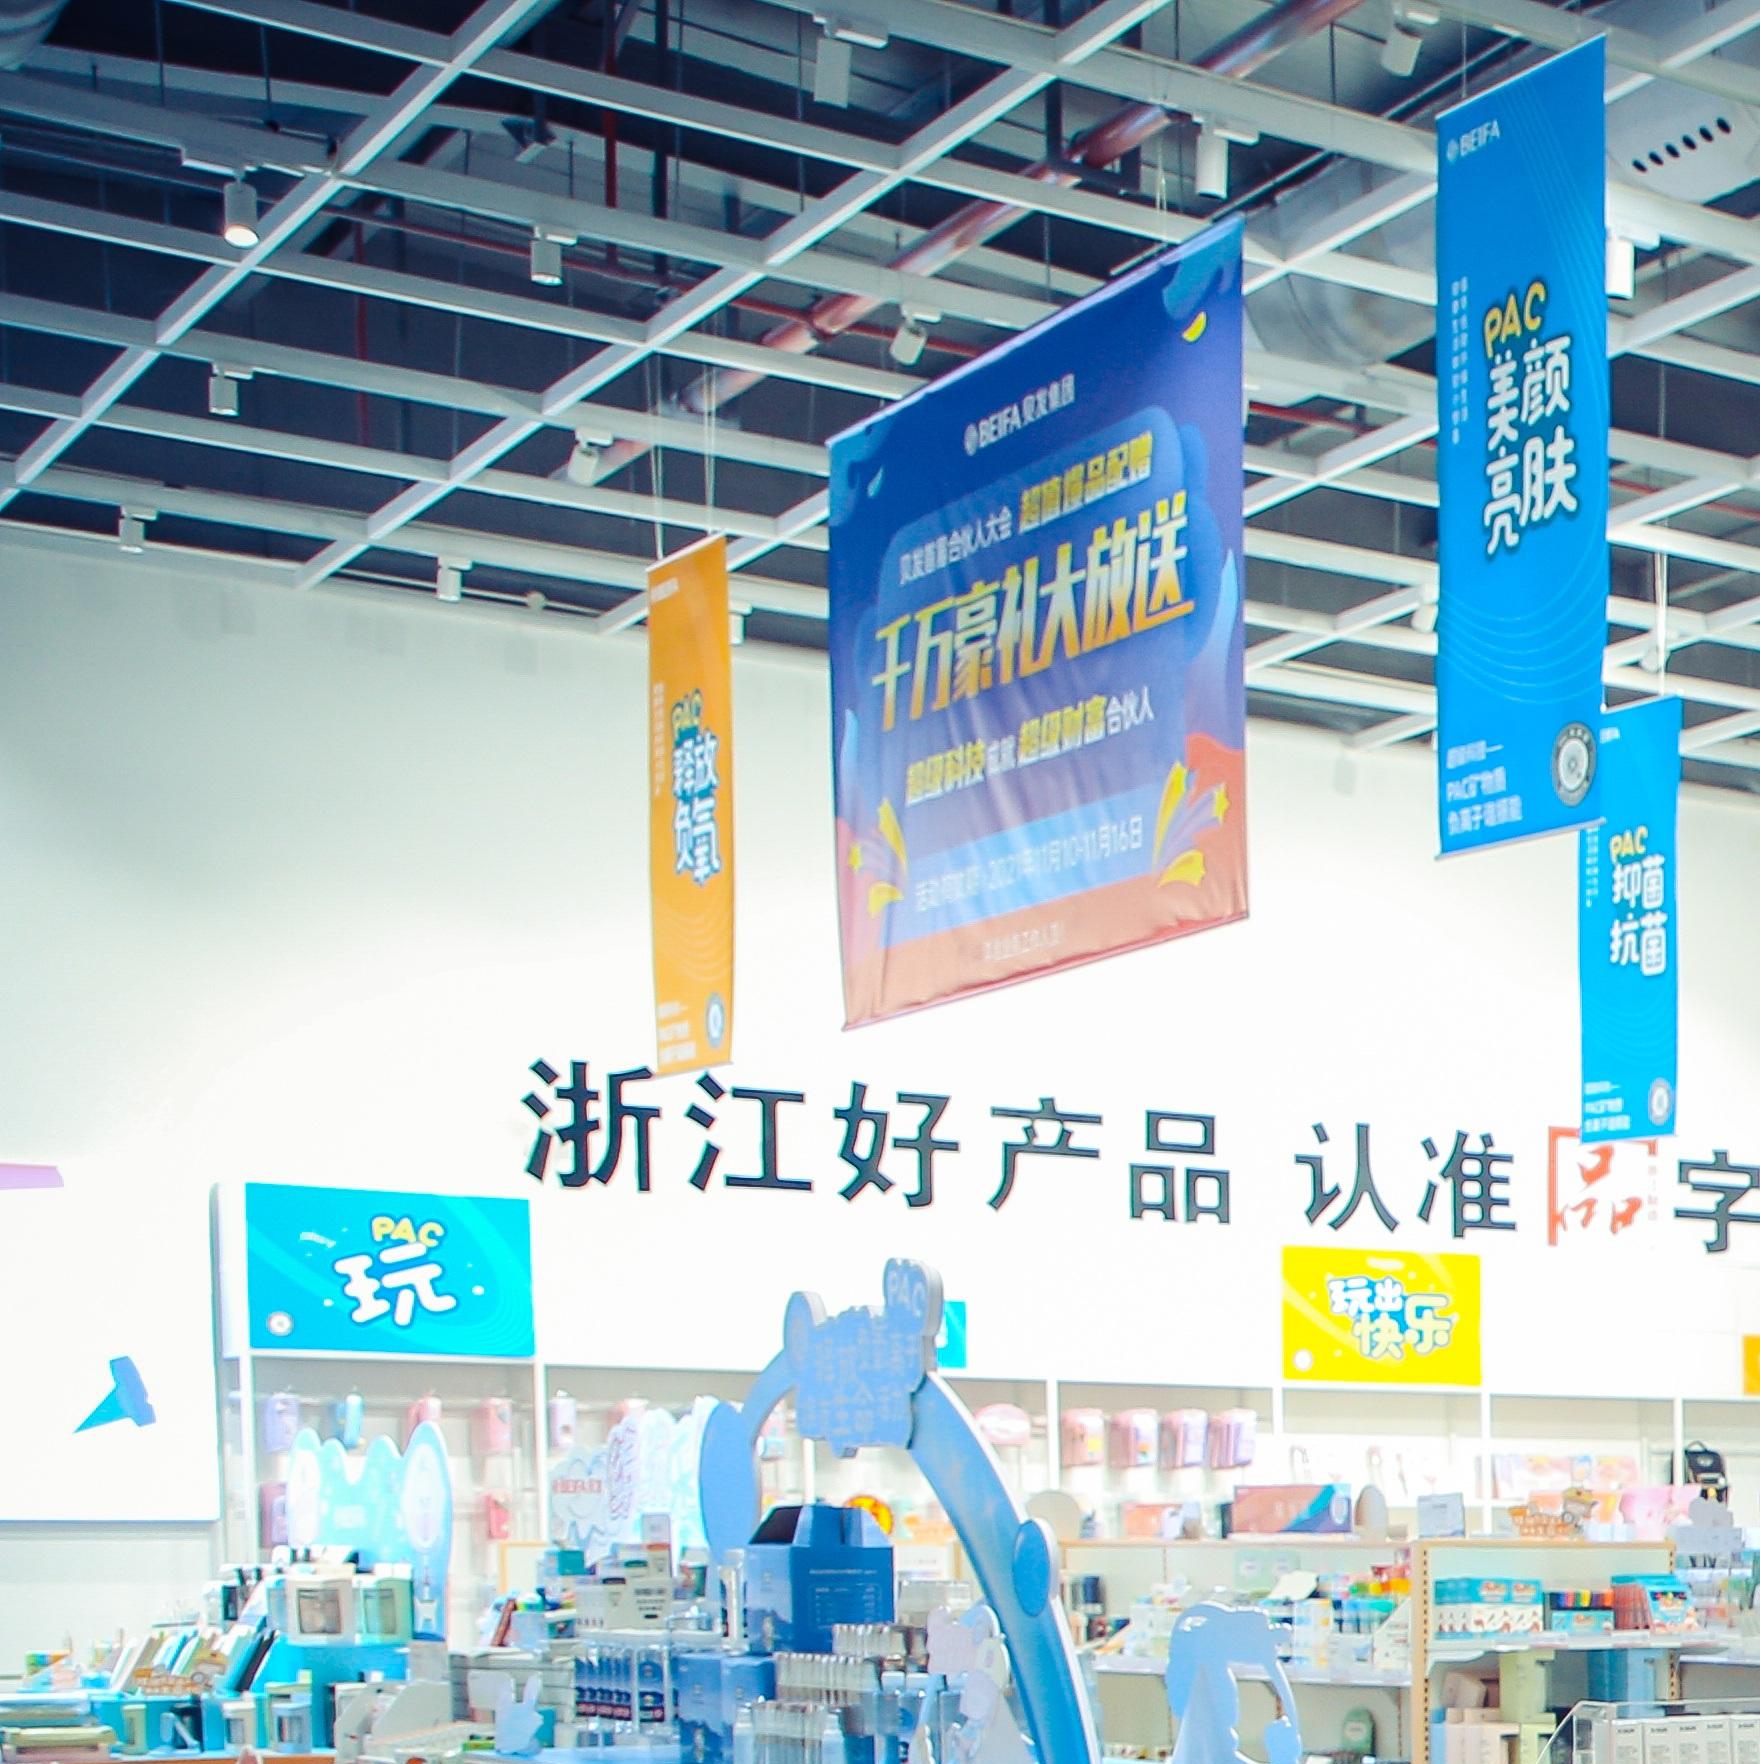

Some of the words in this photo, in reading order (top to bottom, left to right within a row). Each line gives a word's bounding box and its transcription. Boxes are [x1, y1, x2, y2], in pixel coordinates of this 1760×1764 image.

[1484, 281, 1546, 359] PAC
[1487, 335, 1572, 452] 美颜
[1484, 432, 1580, 556] 亮肤
[872, 488, 1195, 732] 千万豪礼大放送
[1609, 825, 1648, 864] PAC
[1610, 853, 1667, 911] 抑菌
[1608, 909, 1669, 979] 抗菌
[520, 1055, 1232, 1226] 浙江好产品
[372, 1216, 444, 1249] PAC
[334, 1241, 457, 1327] 玩
[1327, 1275, 1405, 1317] 玩出
[1352, 1292, 1454, 1360] 快乐
